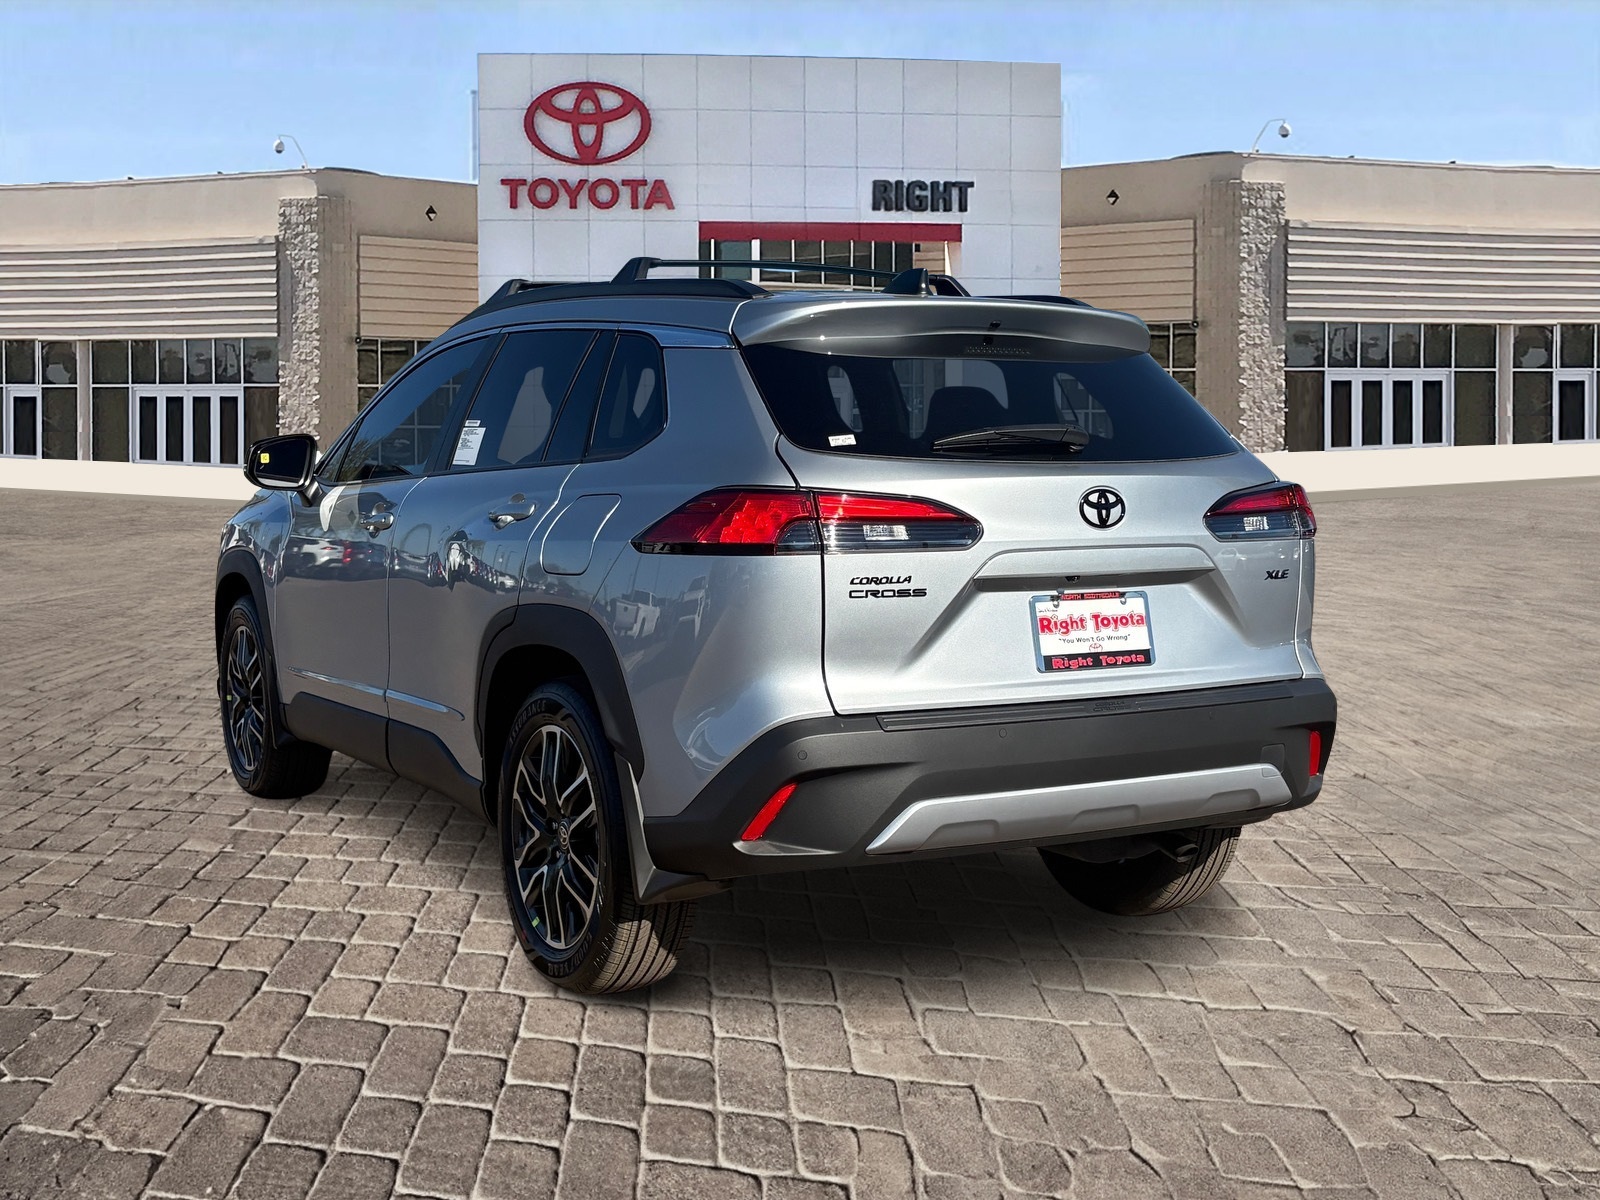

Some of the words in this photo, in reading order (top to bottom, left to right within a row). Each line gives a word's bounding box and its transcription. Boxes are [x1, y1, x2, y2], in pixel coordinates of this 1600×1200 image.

[500, 177, 675, 210] TOYOTA
[871, 179, 975, 212] RIGHT
[849, 575, 912, 586] COROLLA
[1264, 568, 1290, 581] XLE
[848, 588, 927, 599] CROSS
[1038, 613, 1087, 635] Right
[1090, 611, 1146, 633] Toyota
[1051, 657, 1093, 669] Right
[1099, 654, 1145, 666] Toyota
